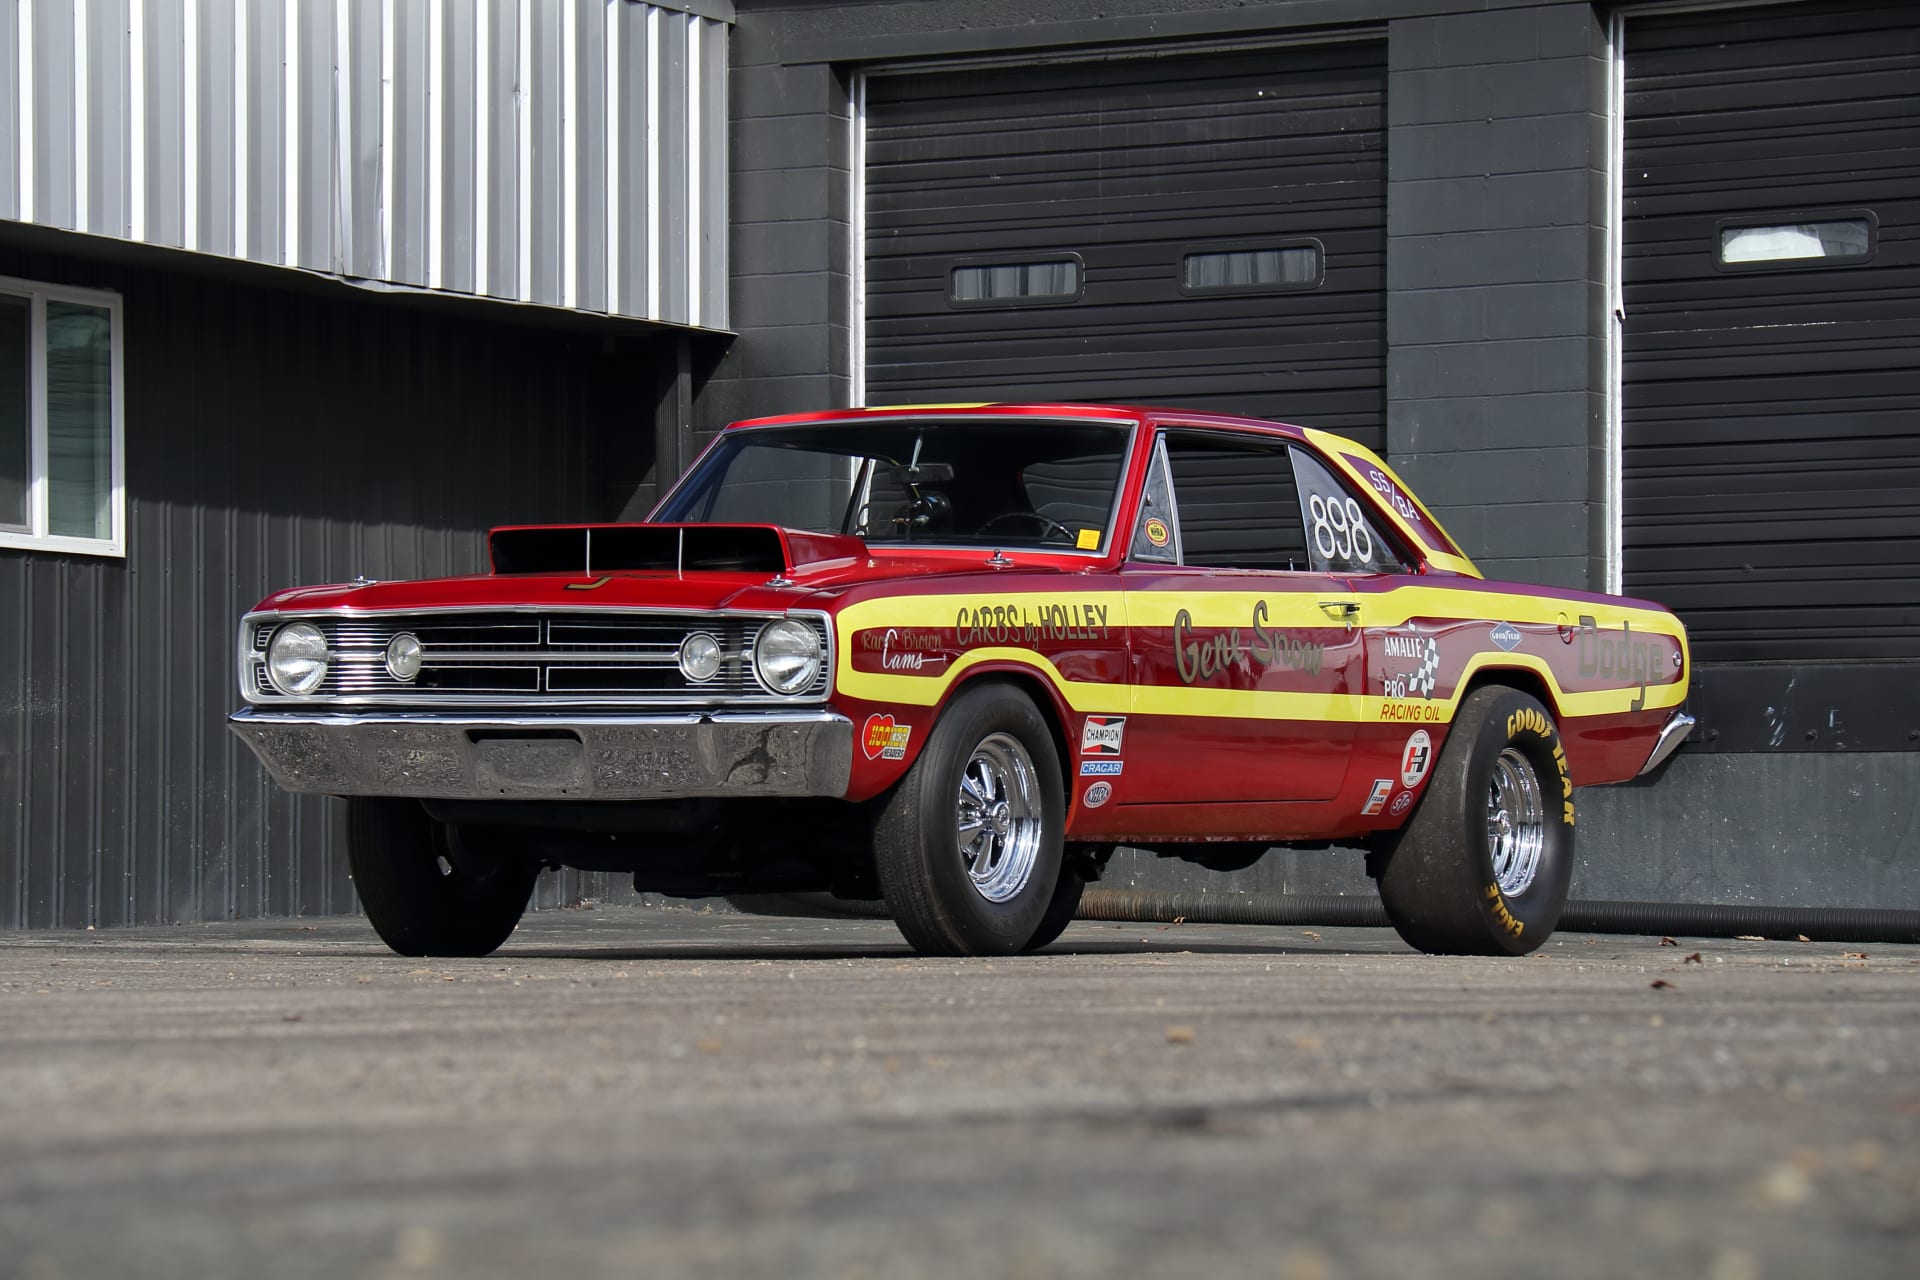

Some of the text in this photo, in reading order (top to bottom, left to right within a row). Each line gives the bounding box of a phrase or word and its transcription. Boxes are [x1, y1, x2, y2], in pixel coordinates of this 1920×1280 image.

[1369, 470, 1421, 521] SS/BA
[1309, 494, 1373, 563] 898
[956, 604, 1109, 650] CARBS by HOLLEY
[1491, 630, 1520, 643] GOODYEAR
[861, 629, 942, 650] Racr Brown
[882, 628, 923, 670] Cams
[1174, 599, 1325, 684] Gene Snow
[1384, 636, 1422, 659] AMALIE
[1578, 614, 1664, 712] Dodge
[1384, 679, 1405, 700] PRO
[1380, 703, 1440, 721] RACING OIL
[1086, 728, 1120, 742] CHAMPION
[1082, 763, 1121, 773] CRAGAR
[1087, 786, 1109, 803] NHRA
[1392, 794, 1410, 811] STP
